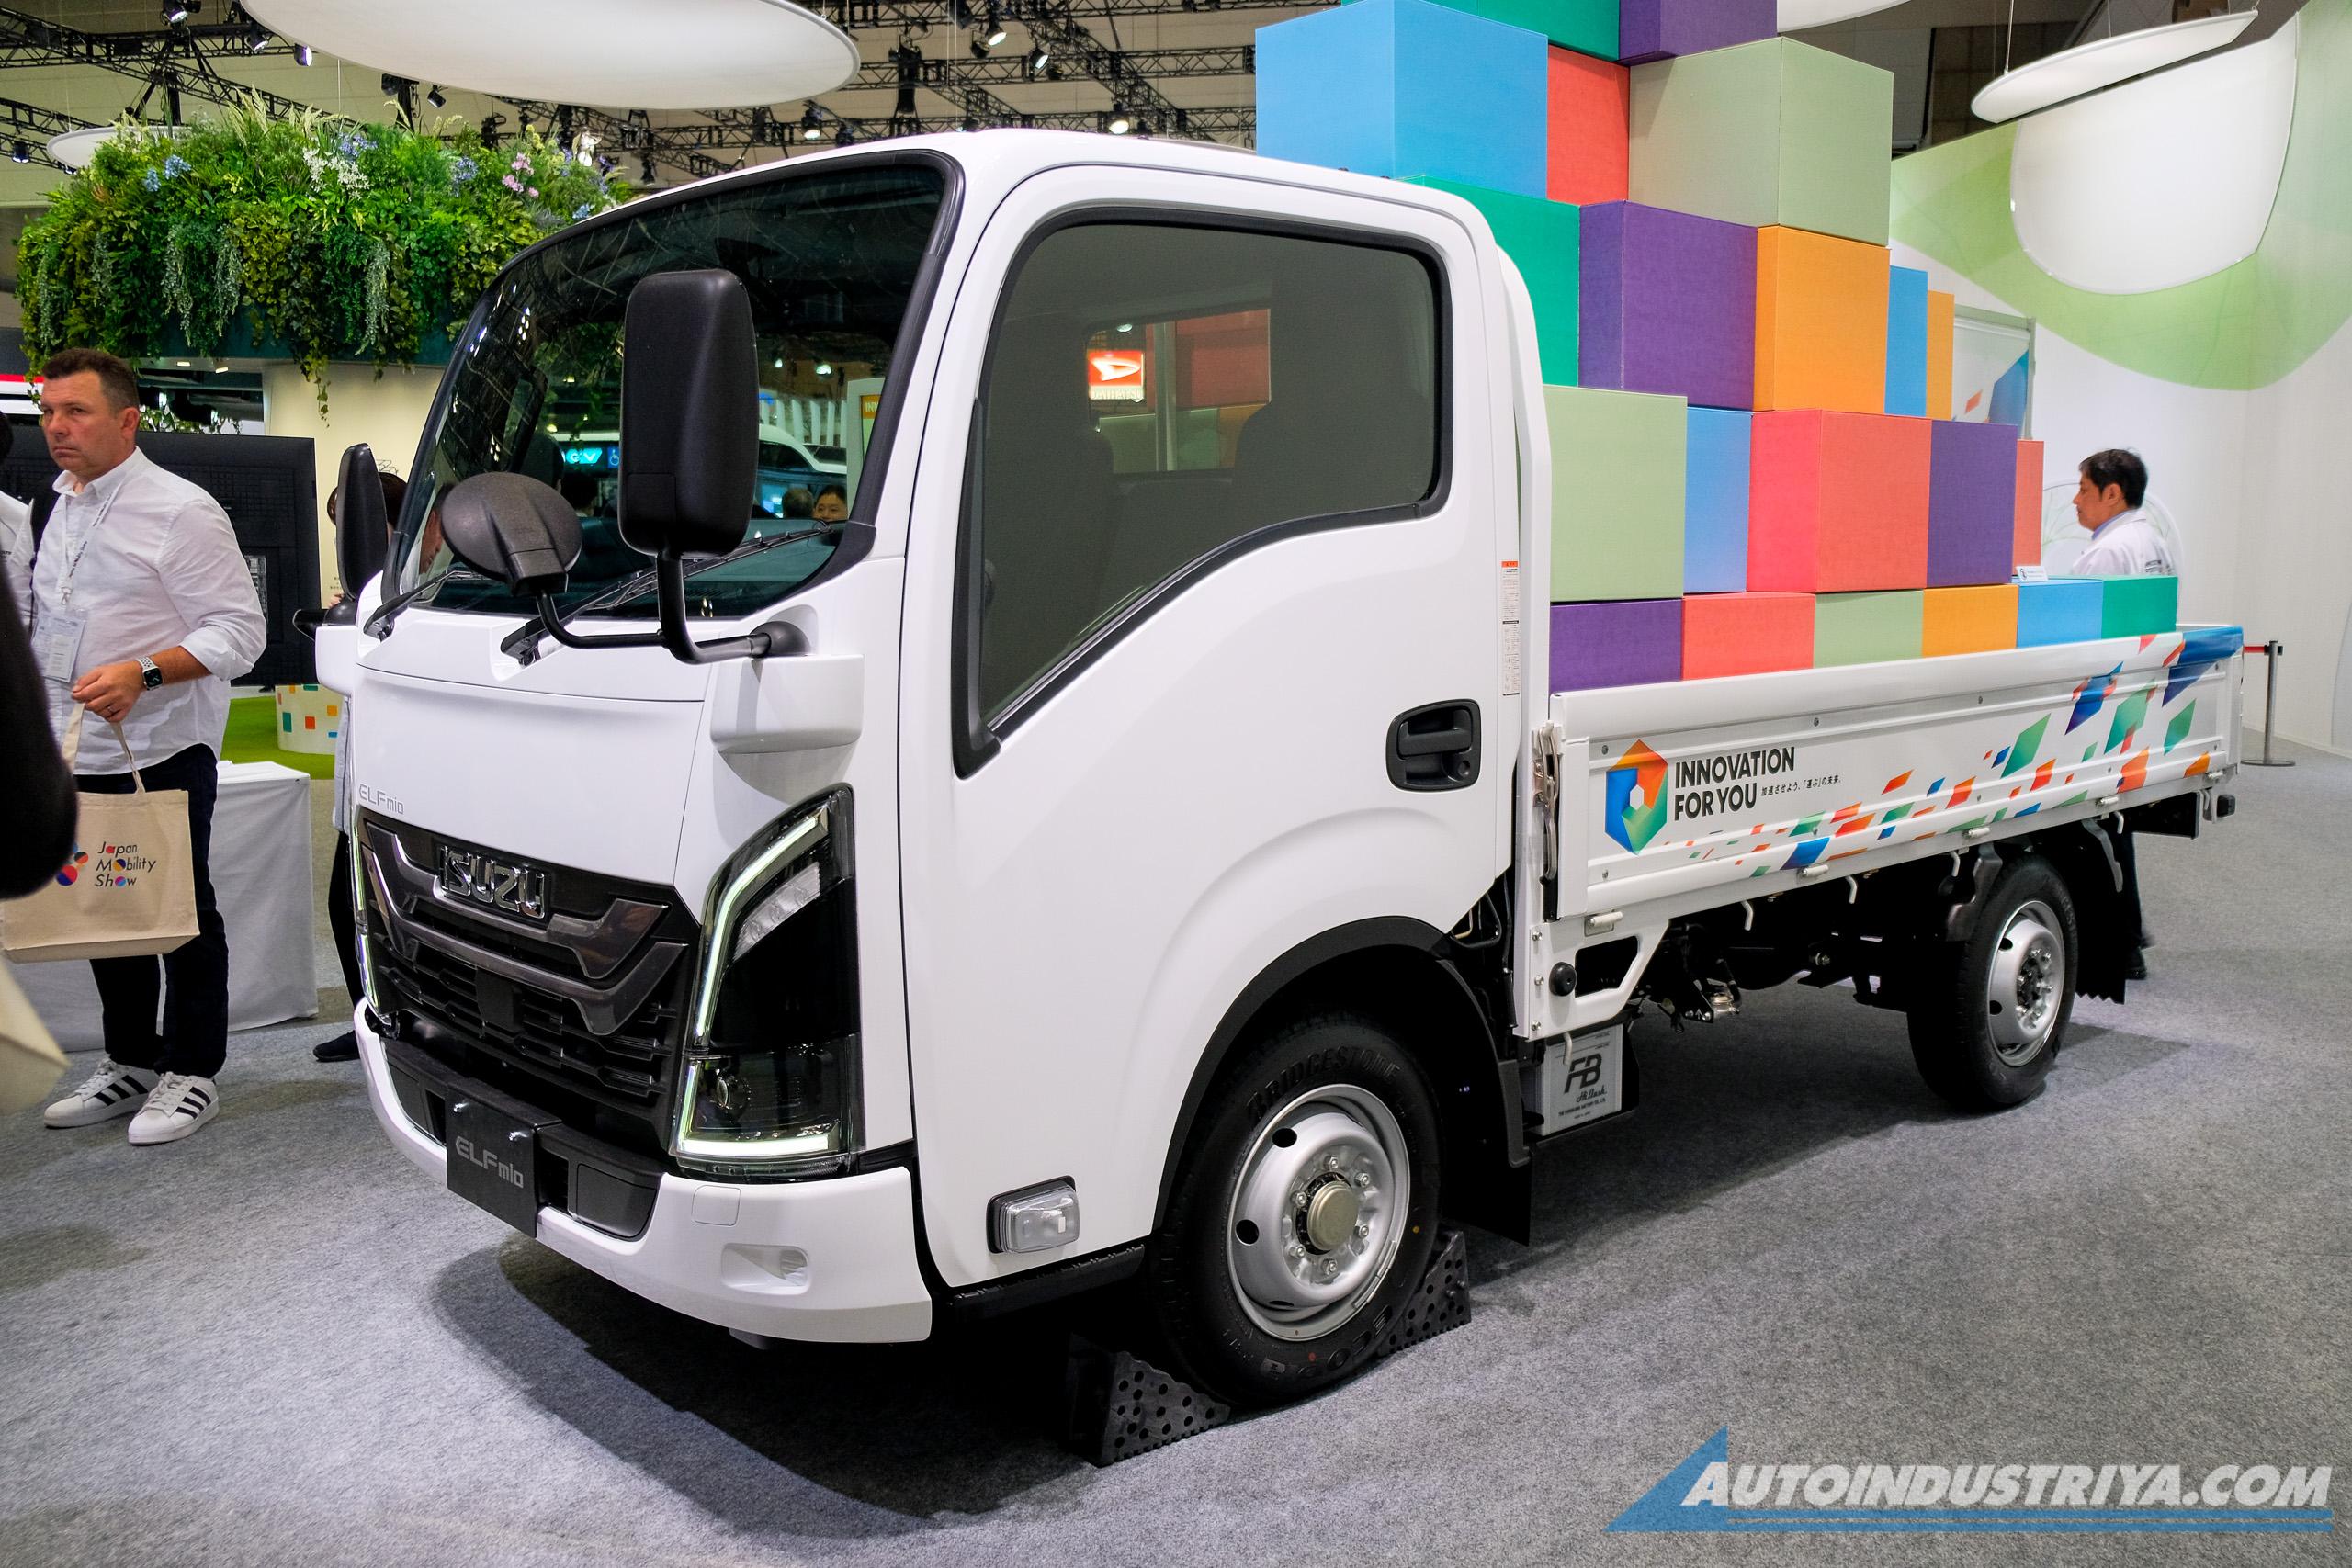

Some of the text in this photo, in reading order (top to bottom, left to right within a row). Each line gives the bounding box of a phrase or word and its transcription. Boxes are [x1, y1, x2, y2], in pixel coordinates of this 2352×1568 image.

[1674, 746, 1795, 789] INNOVATION
[1674, 782, 1758, 822] FOR YOU
[96, 840, 139, 859] Japan
[96, 855, 157, 874] Mobility
[94, 873, 137, 888] Show
[439, 844, 545, 919] ISUZU
[1563, 1053, 1602, 1094] FB
